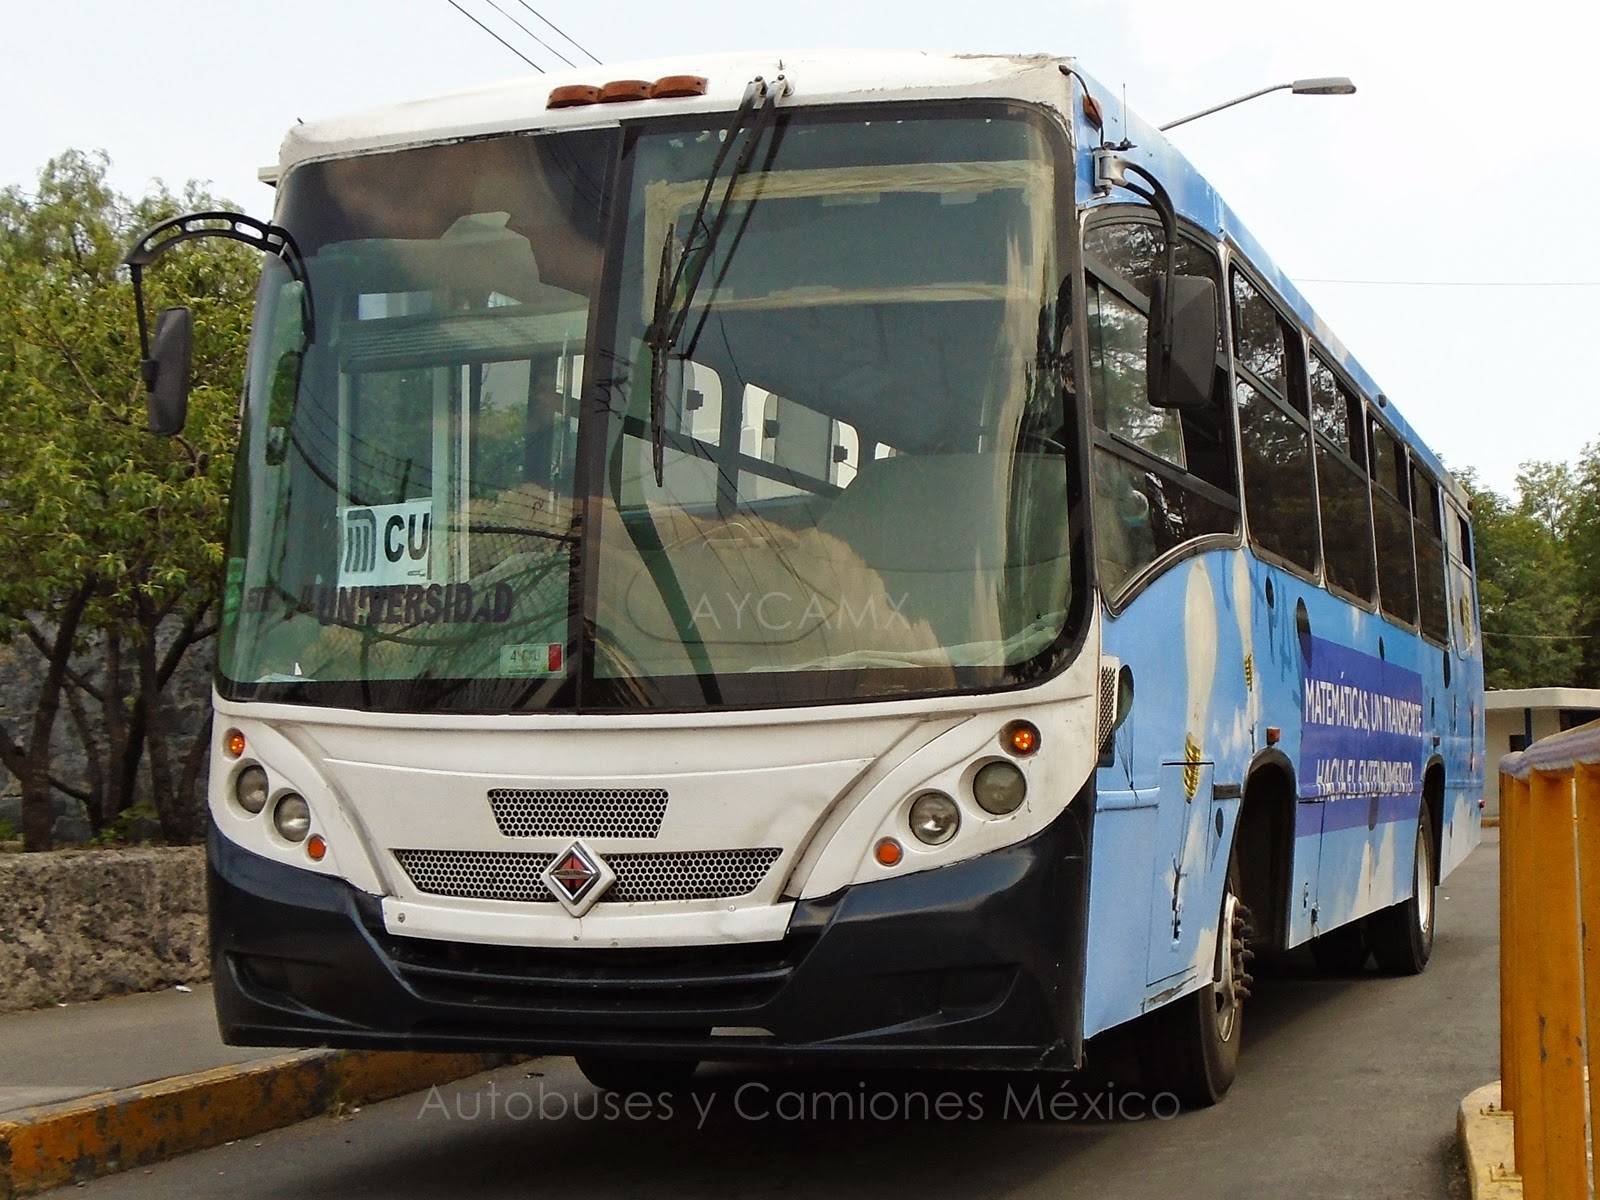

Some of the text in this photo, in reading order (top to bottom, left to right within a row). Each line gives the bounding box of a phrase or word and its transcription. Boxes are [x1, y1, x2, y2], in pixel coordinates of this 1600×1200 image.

[384, 512, 430, 563] CU
[318, 583, 513, 626] UNIVERSIDAD
[1371, 692, 1383, 732] UN
[1384, 695, 1422, 738] TRANSPORTE
[1315, 758, 1414, 801] HACIA EL ENTENDIMIENTO
